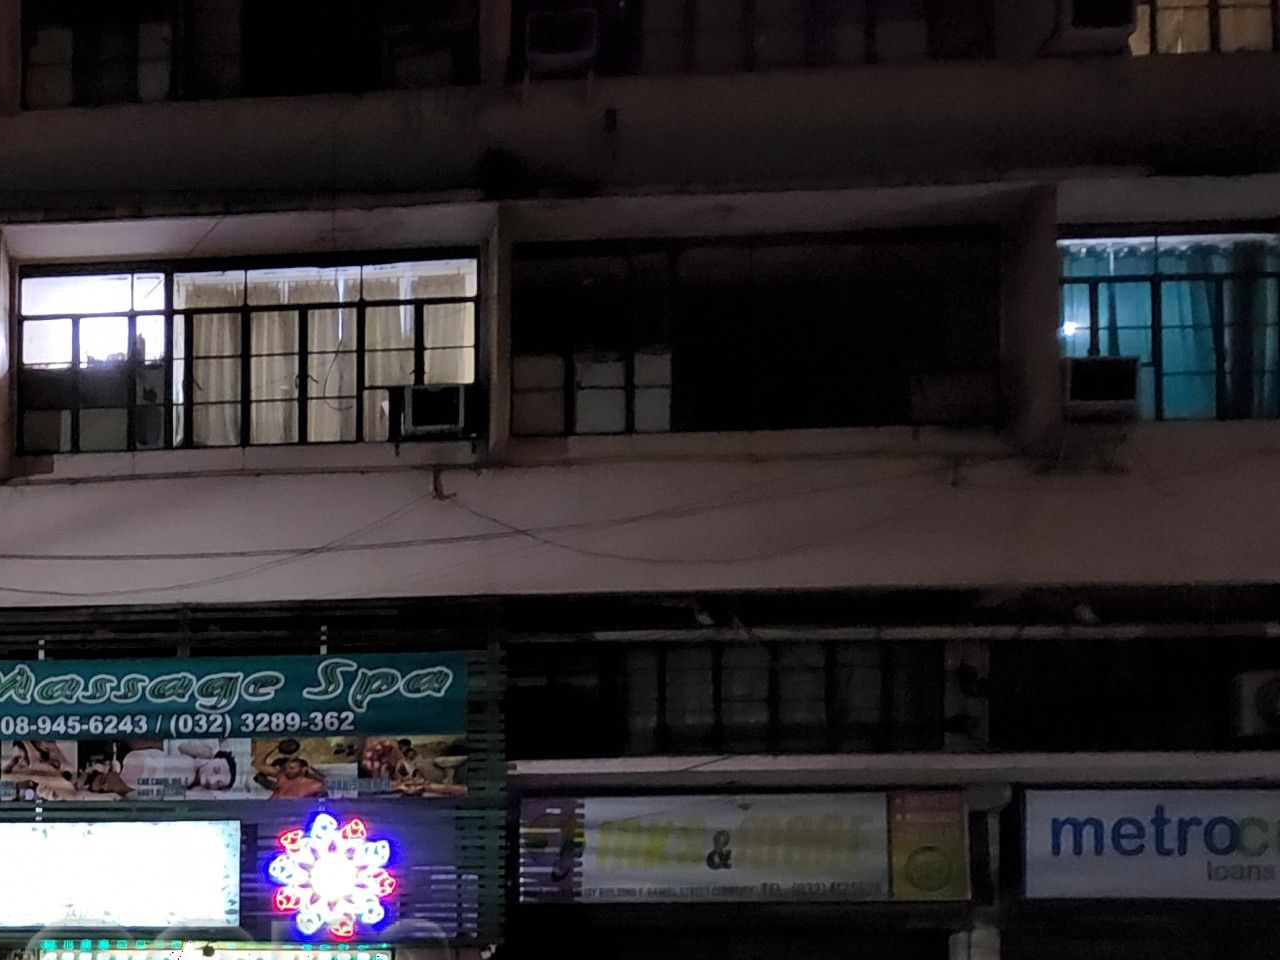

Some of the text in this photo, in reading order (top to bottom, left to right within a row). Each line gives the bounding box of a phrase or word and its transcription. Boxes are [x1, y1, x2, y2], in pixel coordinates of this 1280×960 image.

[303, 659, 452, 712] Spa
[171, 713, 232, 737] (032)
[240, 711, 355, 733] 3289-362
[705, 829, 733, 870] &
[1051, 805, 1280, 857] metroc
[1206, 860, 1276, 881] loans
